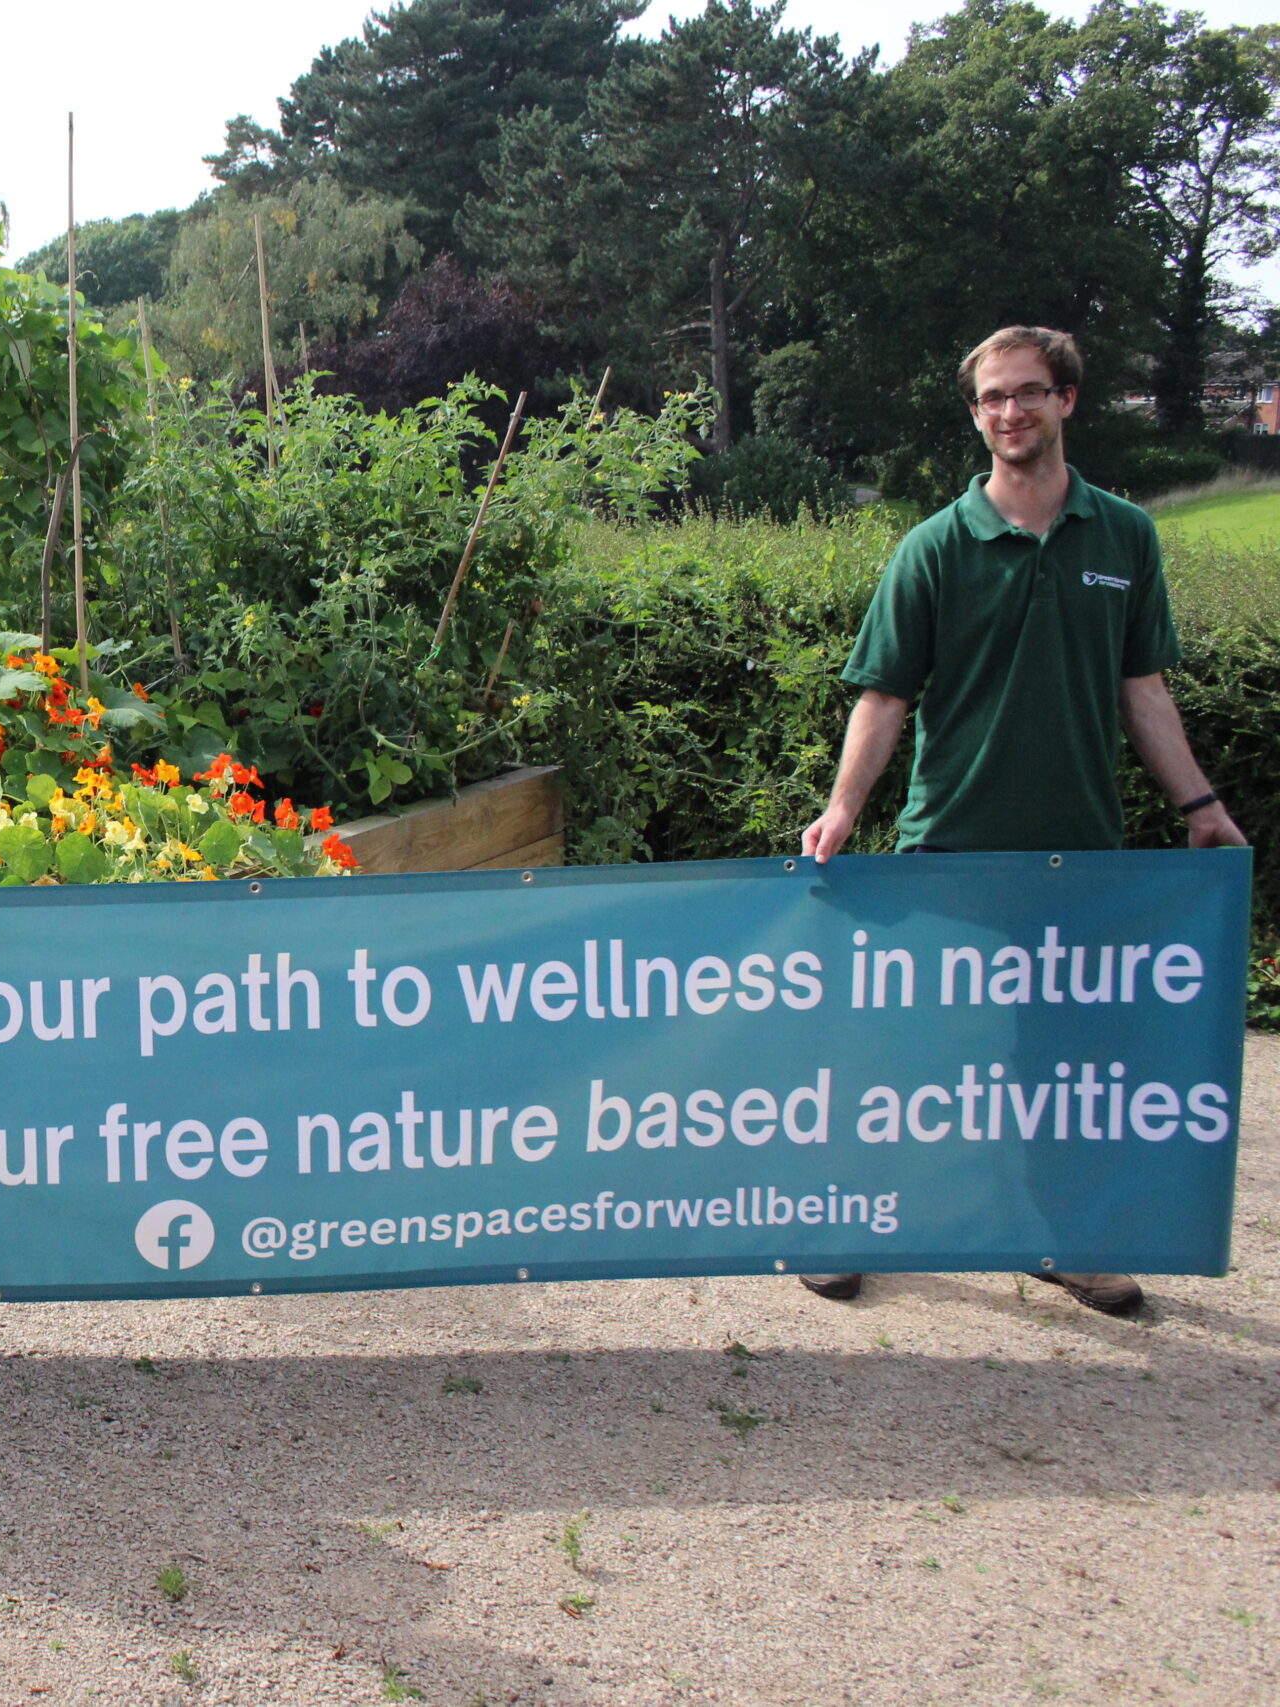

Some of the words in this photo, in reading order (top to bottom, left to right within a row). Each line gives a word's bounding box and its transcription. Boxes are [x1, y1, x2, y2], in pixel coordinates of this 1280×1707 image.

[138, 951, 321, 1057] path
[347, 948, 432, 1027] to
[457, 938, 823, 1023] wellness
[851, 929, 915, 1009] in
[941, 926, 1203, 1006] nature
[98, 1102, 269, 1183] free
[297, 1090, 559, 1174] nature
[586, 1068, 832, 1153] based
[856, 1062, 1228, 1144] activities
[241, 1186, 899, 1261] @greenspacesforwellbeing
